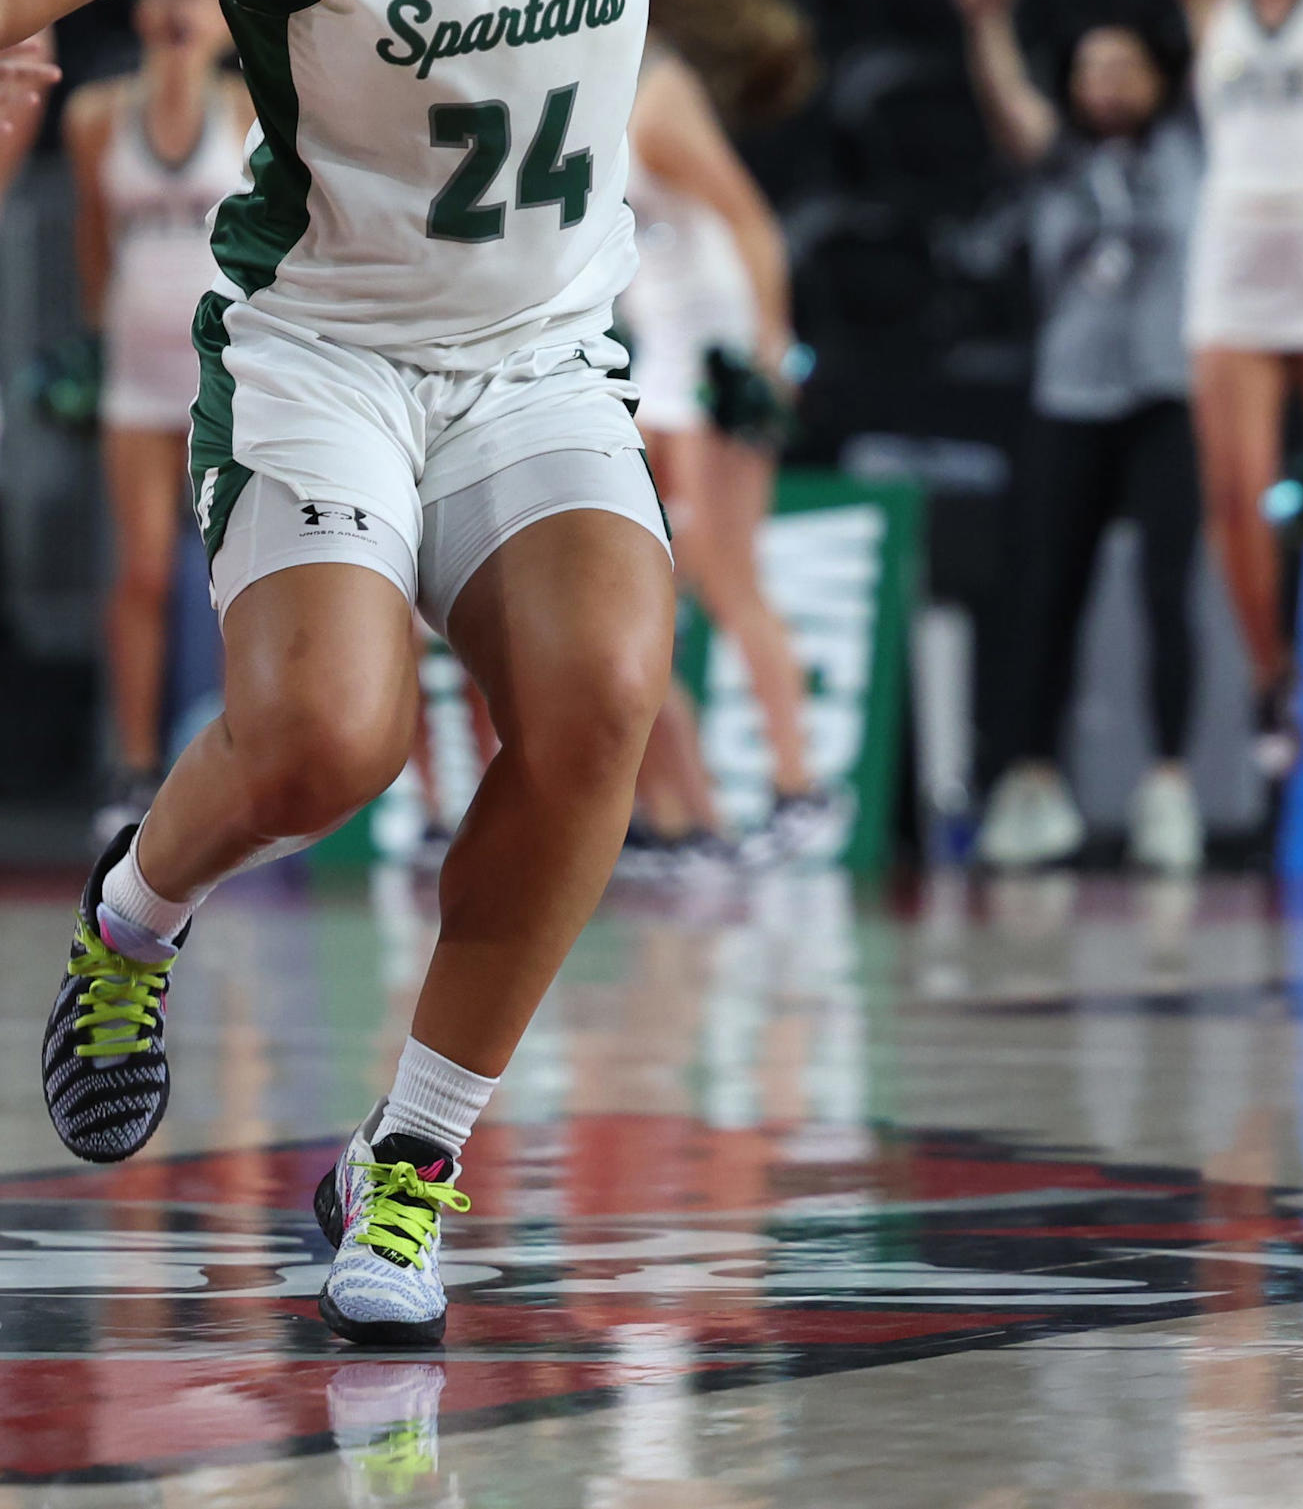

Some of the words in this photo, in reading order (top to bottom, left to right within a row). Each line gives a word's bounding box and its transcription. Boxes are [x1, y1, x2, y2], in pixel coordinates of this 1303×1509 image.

[426, 81, 593, 243] 24
[299, 530, 335, 538] UNDER
[337, 531, 378, 545] ARMOUR
